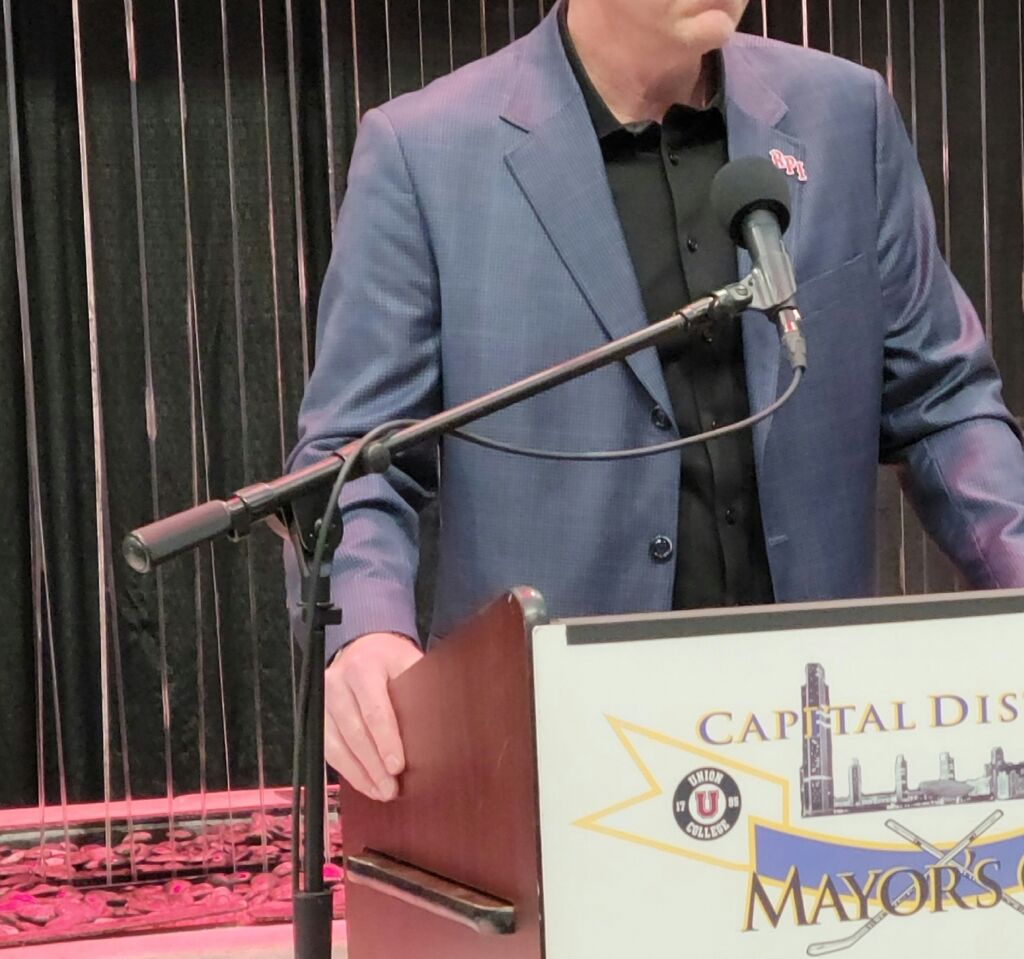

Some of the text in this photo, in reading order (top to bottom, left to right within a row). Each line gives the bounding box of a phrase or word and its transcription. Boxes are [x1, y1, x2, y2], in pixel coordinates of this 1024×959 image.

[769, 149, 807, 181] RPI
[695, 699, 916, 745] CAPITAL
[687, 769, 724, 787] UNION
[676, 800, 686, 812] 17
[695, 789, 719, 819] U
[685, 819, 730, 839] COLLEGE
[741, 847, 1002, 933] MAYOR'S
